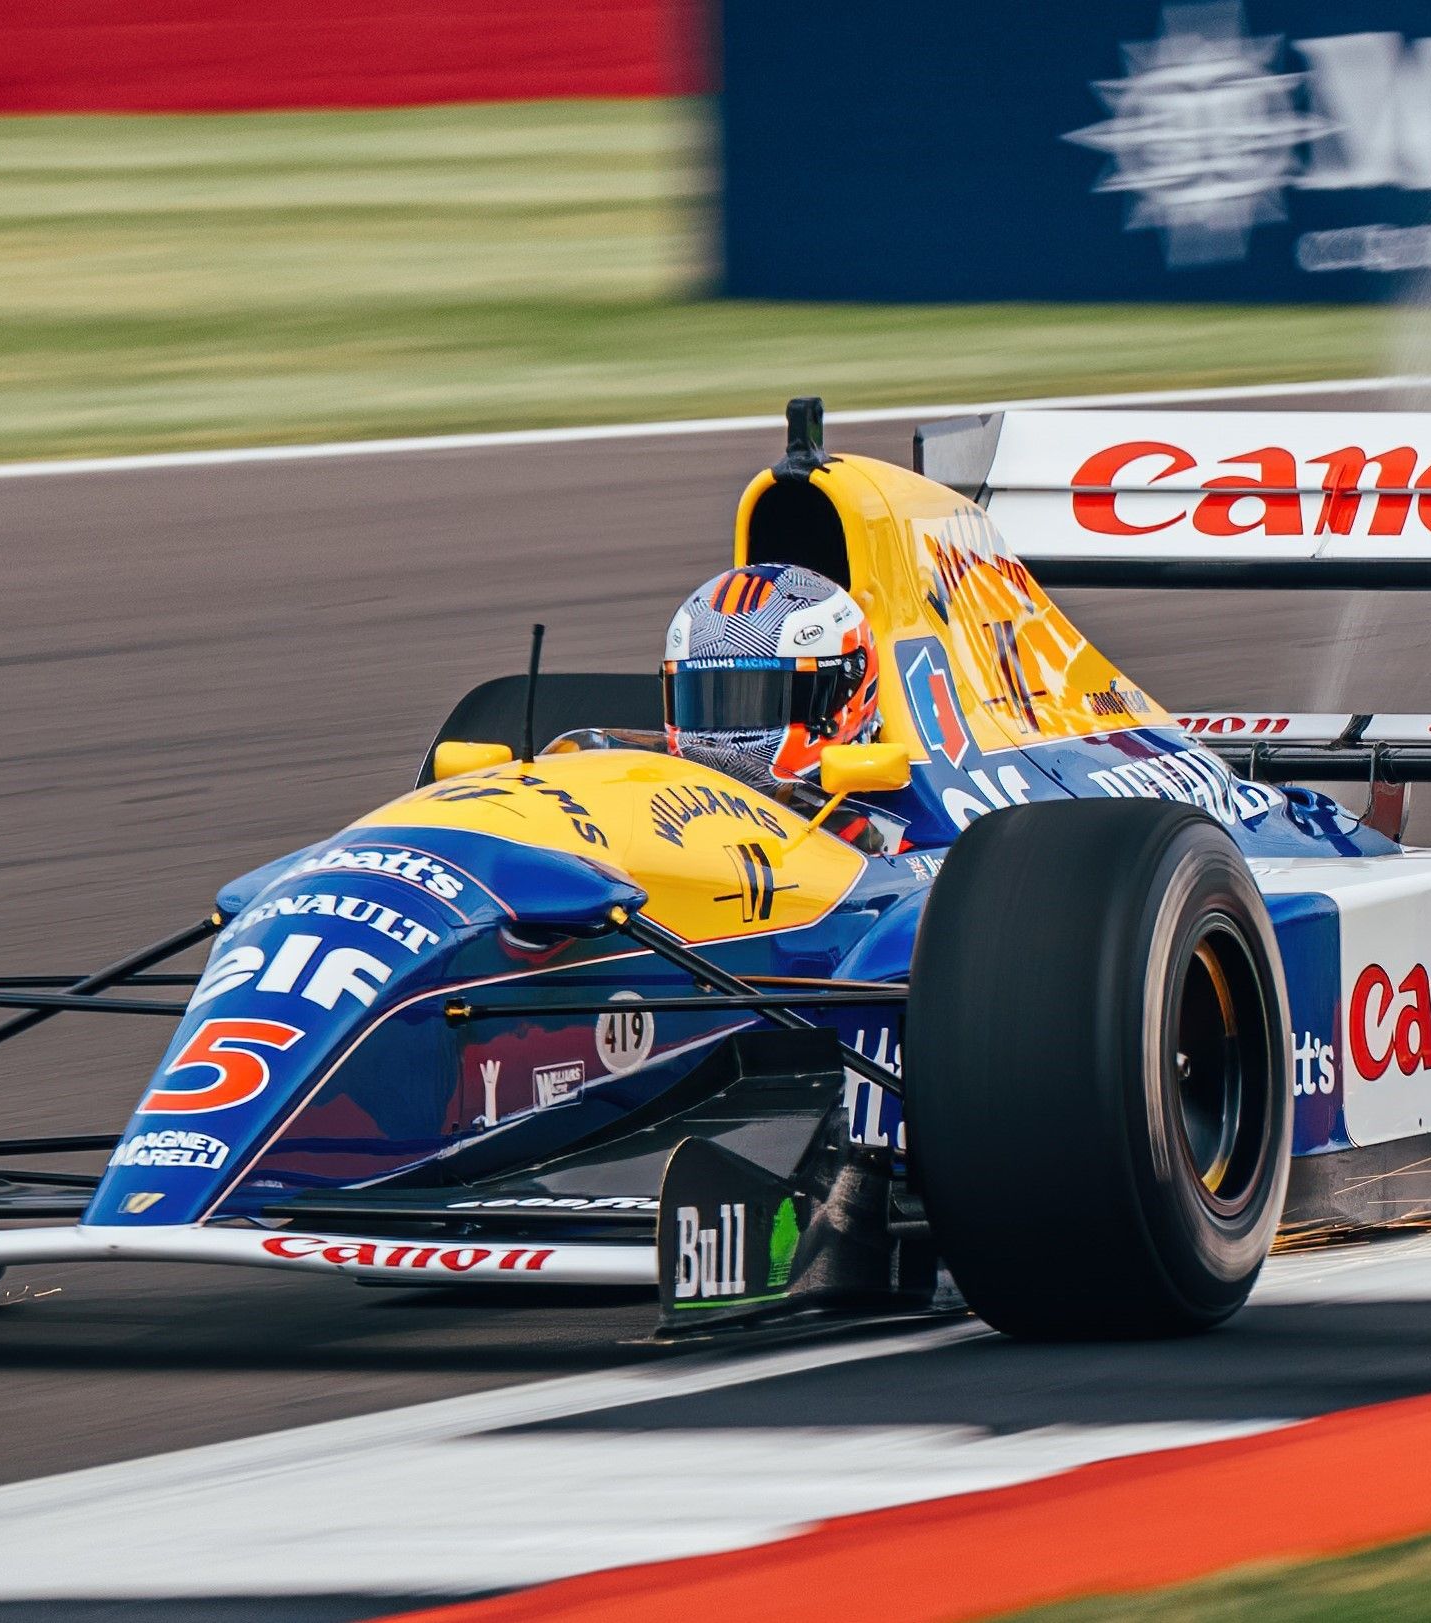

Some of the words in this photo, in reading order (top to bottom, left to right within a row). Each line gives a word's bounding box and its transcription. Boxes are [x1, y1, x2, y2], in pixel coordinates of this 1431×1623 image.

[685, 658, 735, 669] WILLIAMS
[735, 658, 780, 669] RACING
[1177, 717, 1290, 734] non
[651, 785, 788, 848] WILLIAMS
[187, 933, 393, 1011] elf
[605, 1012, 644, 1053] 419
[137, 1017, 306, 1115] 5
[262, 1236, 555, 1271] Canon
[675, 1203, 746, 1298] Bull
